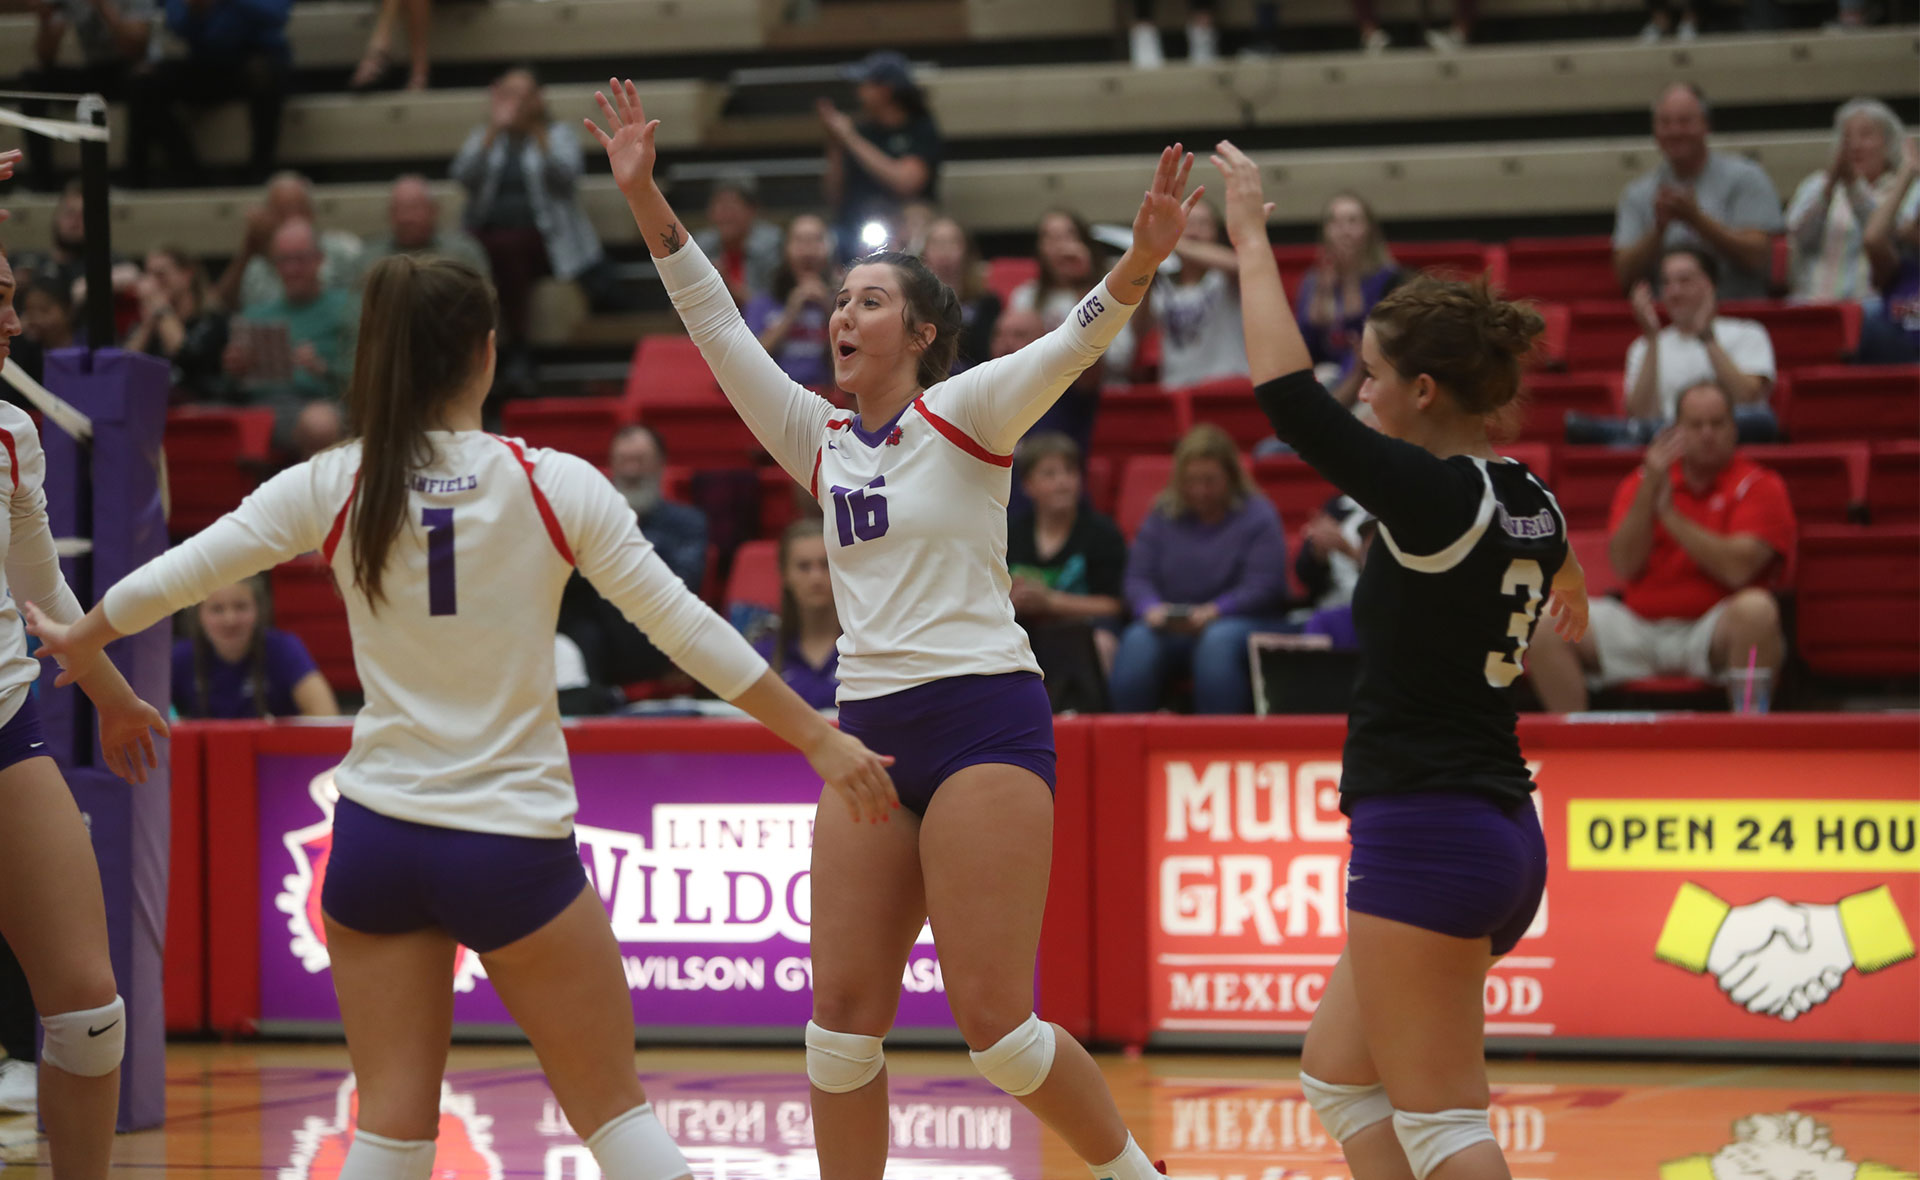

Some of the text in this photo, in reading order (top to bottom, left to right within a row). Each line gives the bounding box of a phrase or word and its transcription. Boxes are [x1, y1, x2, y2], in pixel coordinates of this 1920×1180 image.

[1077, 295, 1105, 328] CATS
[830, 475, 890, 547] 16
[421, 507, 457, 616] 1
[1484, 558, 1545, 688] 3
[668, 819, 815, 849] LINFI
[1588, 815, 1915, 854] OPEN 24 HOU
[1169, 972, 1326, 1013] MEXIC
